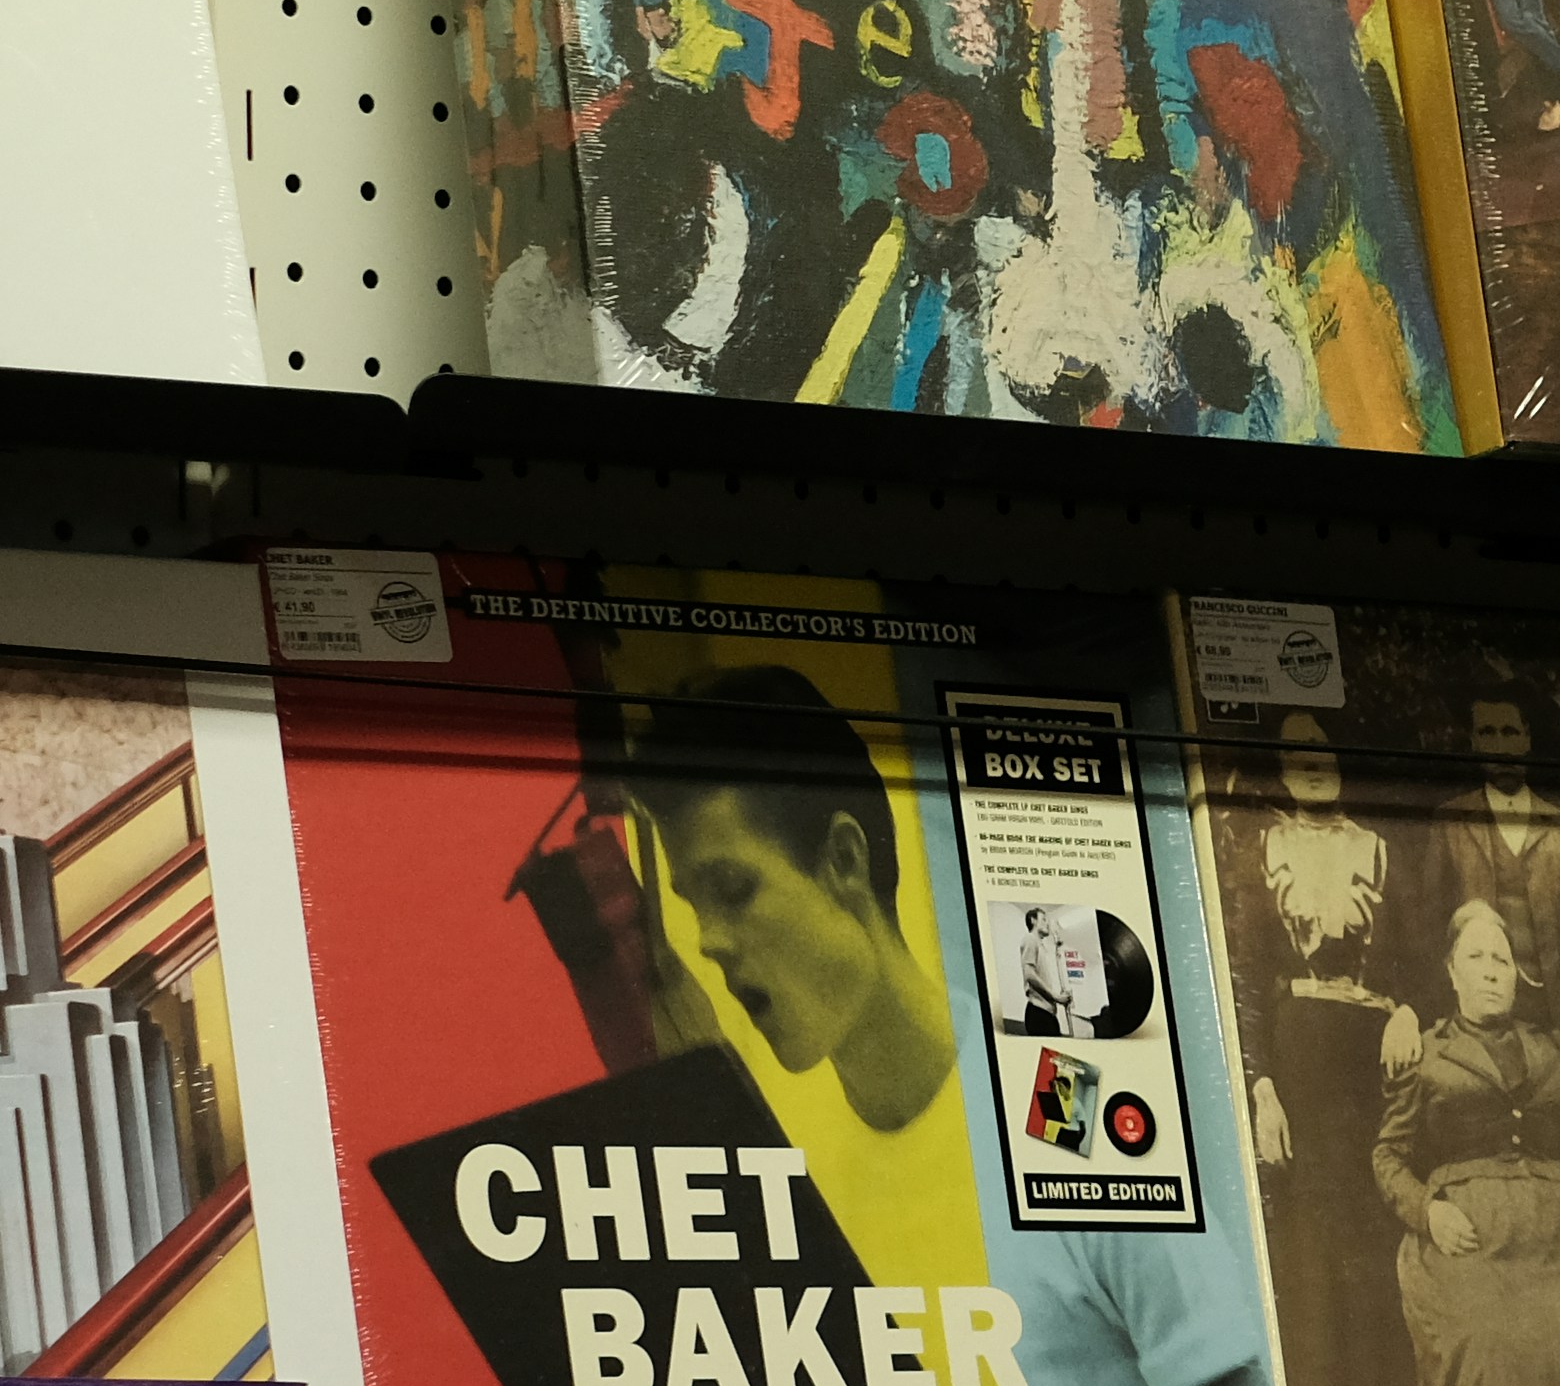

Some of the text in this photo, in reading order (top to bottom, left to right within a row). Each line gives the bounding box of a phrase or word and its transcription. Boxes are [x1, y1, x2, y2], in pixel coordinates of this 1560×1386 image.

[296, 554, 334, 565] BAKER
[470, 592, 977, 646] THE DEFINITIVE COLLECTOR'S EDITION
[1246, 603, 1289, 617] GUCCINI
[983, 715, 1094, 746] DELUXE
[984, 752, 1103, 784] BOX SET
[454, 1142, 806, 1263] CHET
[1032, 1181, 1177, 1202] LIMITED EDITION
